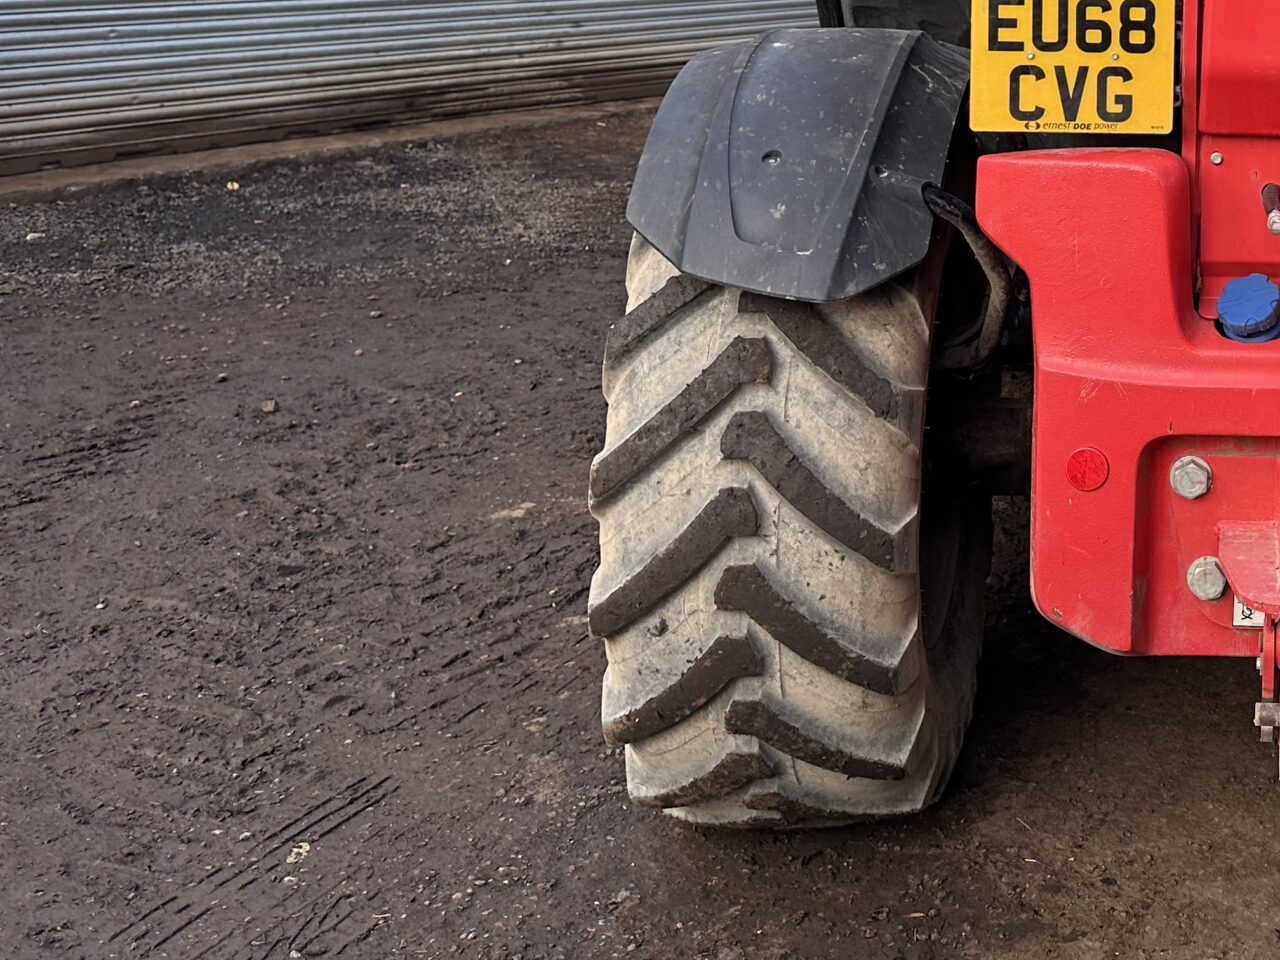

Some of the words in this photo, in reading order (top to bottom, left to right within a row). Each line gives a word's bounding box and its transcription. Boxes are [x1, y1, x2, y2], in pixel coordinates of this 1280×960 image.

[1009, 64, 1134, 123] CVG
[1042, 122, 1071, 130] ernest
[1073, 122, 1092, 130] DOE
[1093, 122, 1118, 131] power
